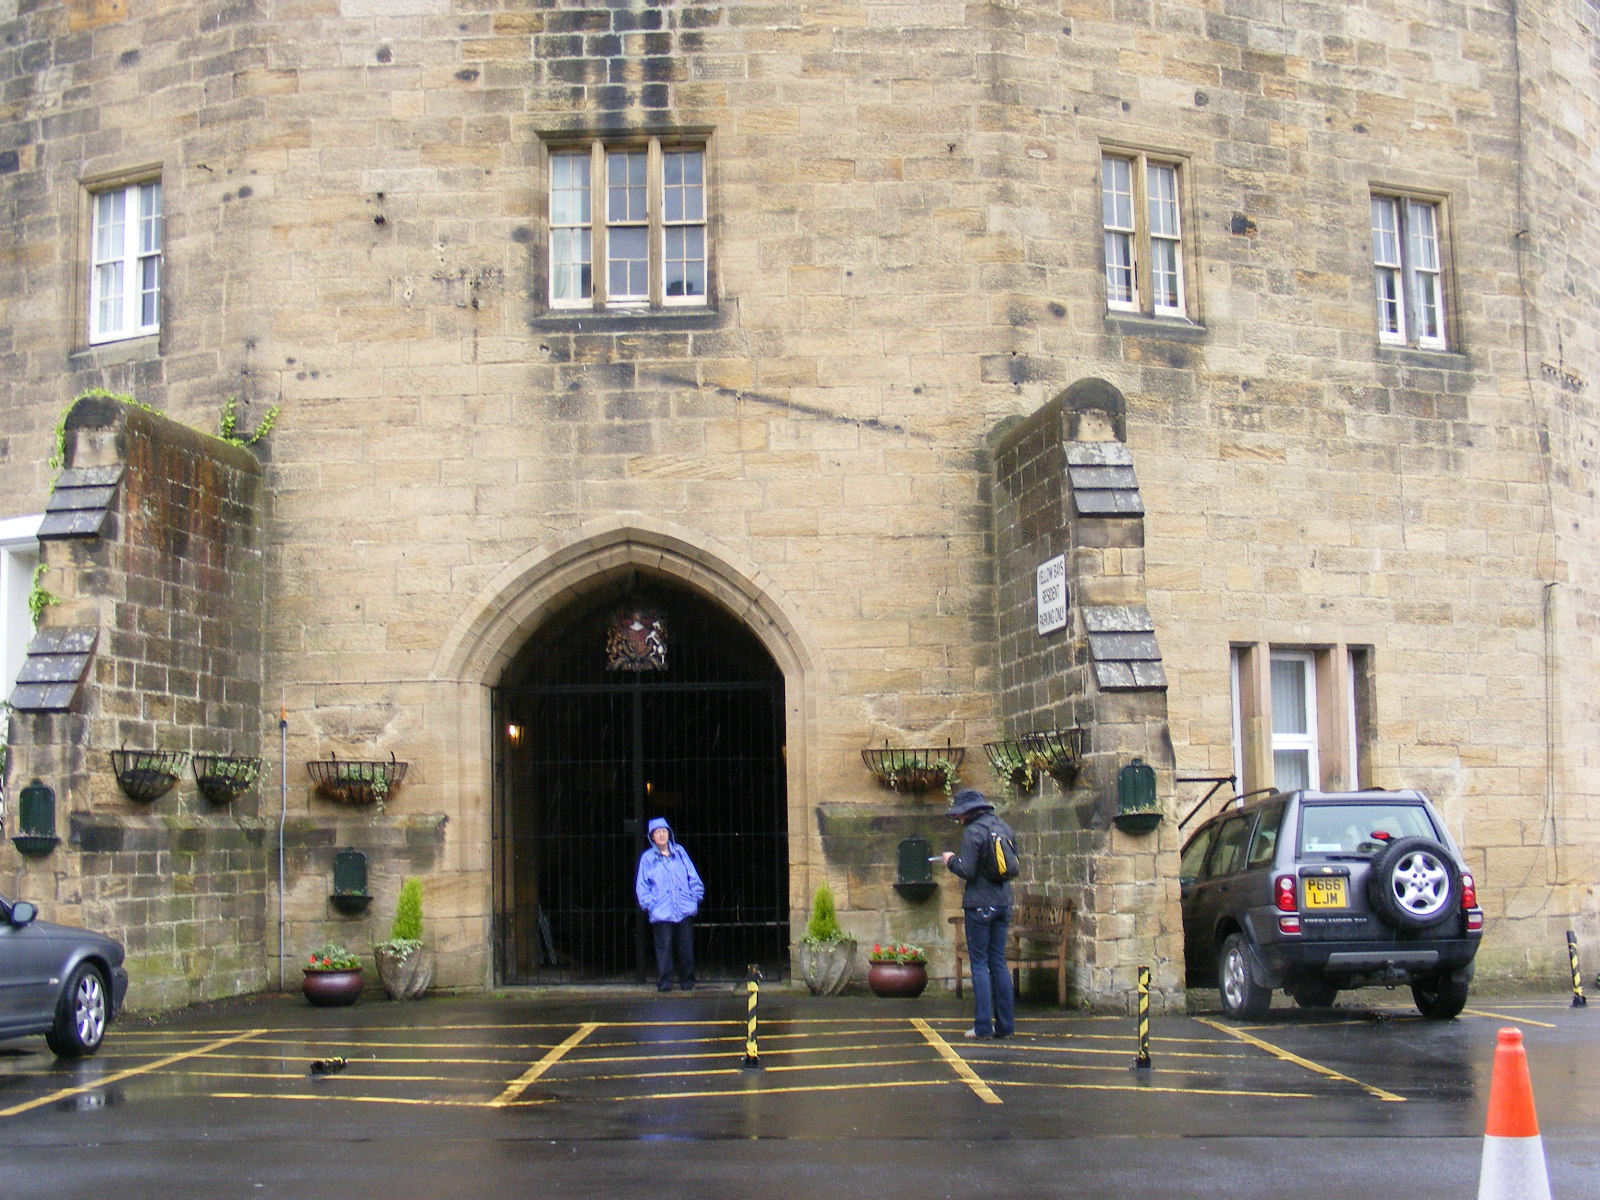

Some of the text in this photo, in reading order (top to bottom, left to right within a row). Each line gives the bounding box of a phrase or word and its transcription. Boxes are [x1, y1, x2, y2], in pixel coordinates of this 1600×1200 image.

[1053, 560, 1064, 578] BAYS
[1042, 583, 1060, 604] RESIDENT
[1039, 606, 1064, 628] PARKING ONLY
[1308, 878, 1341, 891] P666
[1313, 892, 1338, 904] LJM
